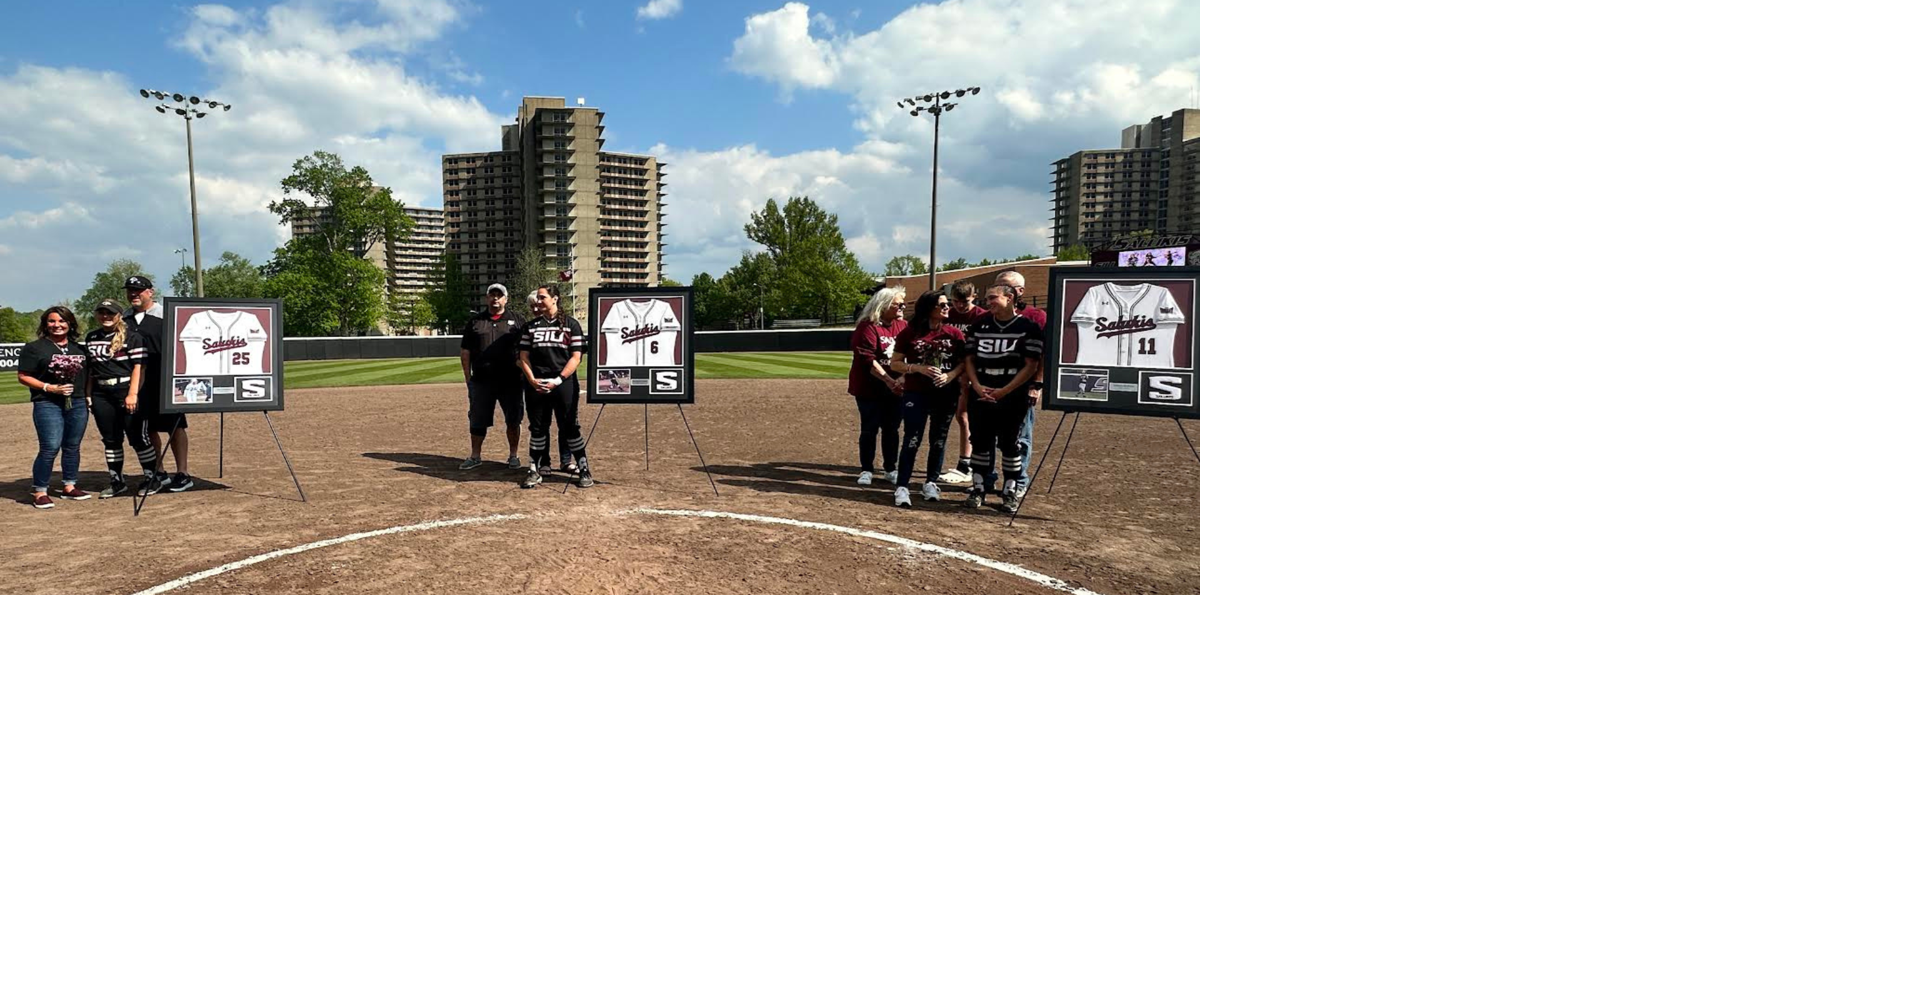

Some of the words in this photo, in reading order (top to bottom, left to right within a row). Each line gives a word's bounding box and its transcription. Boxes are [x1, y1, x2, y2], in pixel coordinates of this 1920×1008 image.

[1095, 315, 1157, 339] Salukis
[533, 331, 564, 343] SIU
[977, 339, 1018, 353] SIU
[1138, 337, 1157, 355] 11
[650, 340, 659, 354] 6
[232, 352, 251, 365] 25
[241, 379, 266, 399] S
[656, 371, 678, 391] S
[1148, 375, 1182, 400] S
